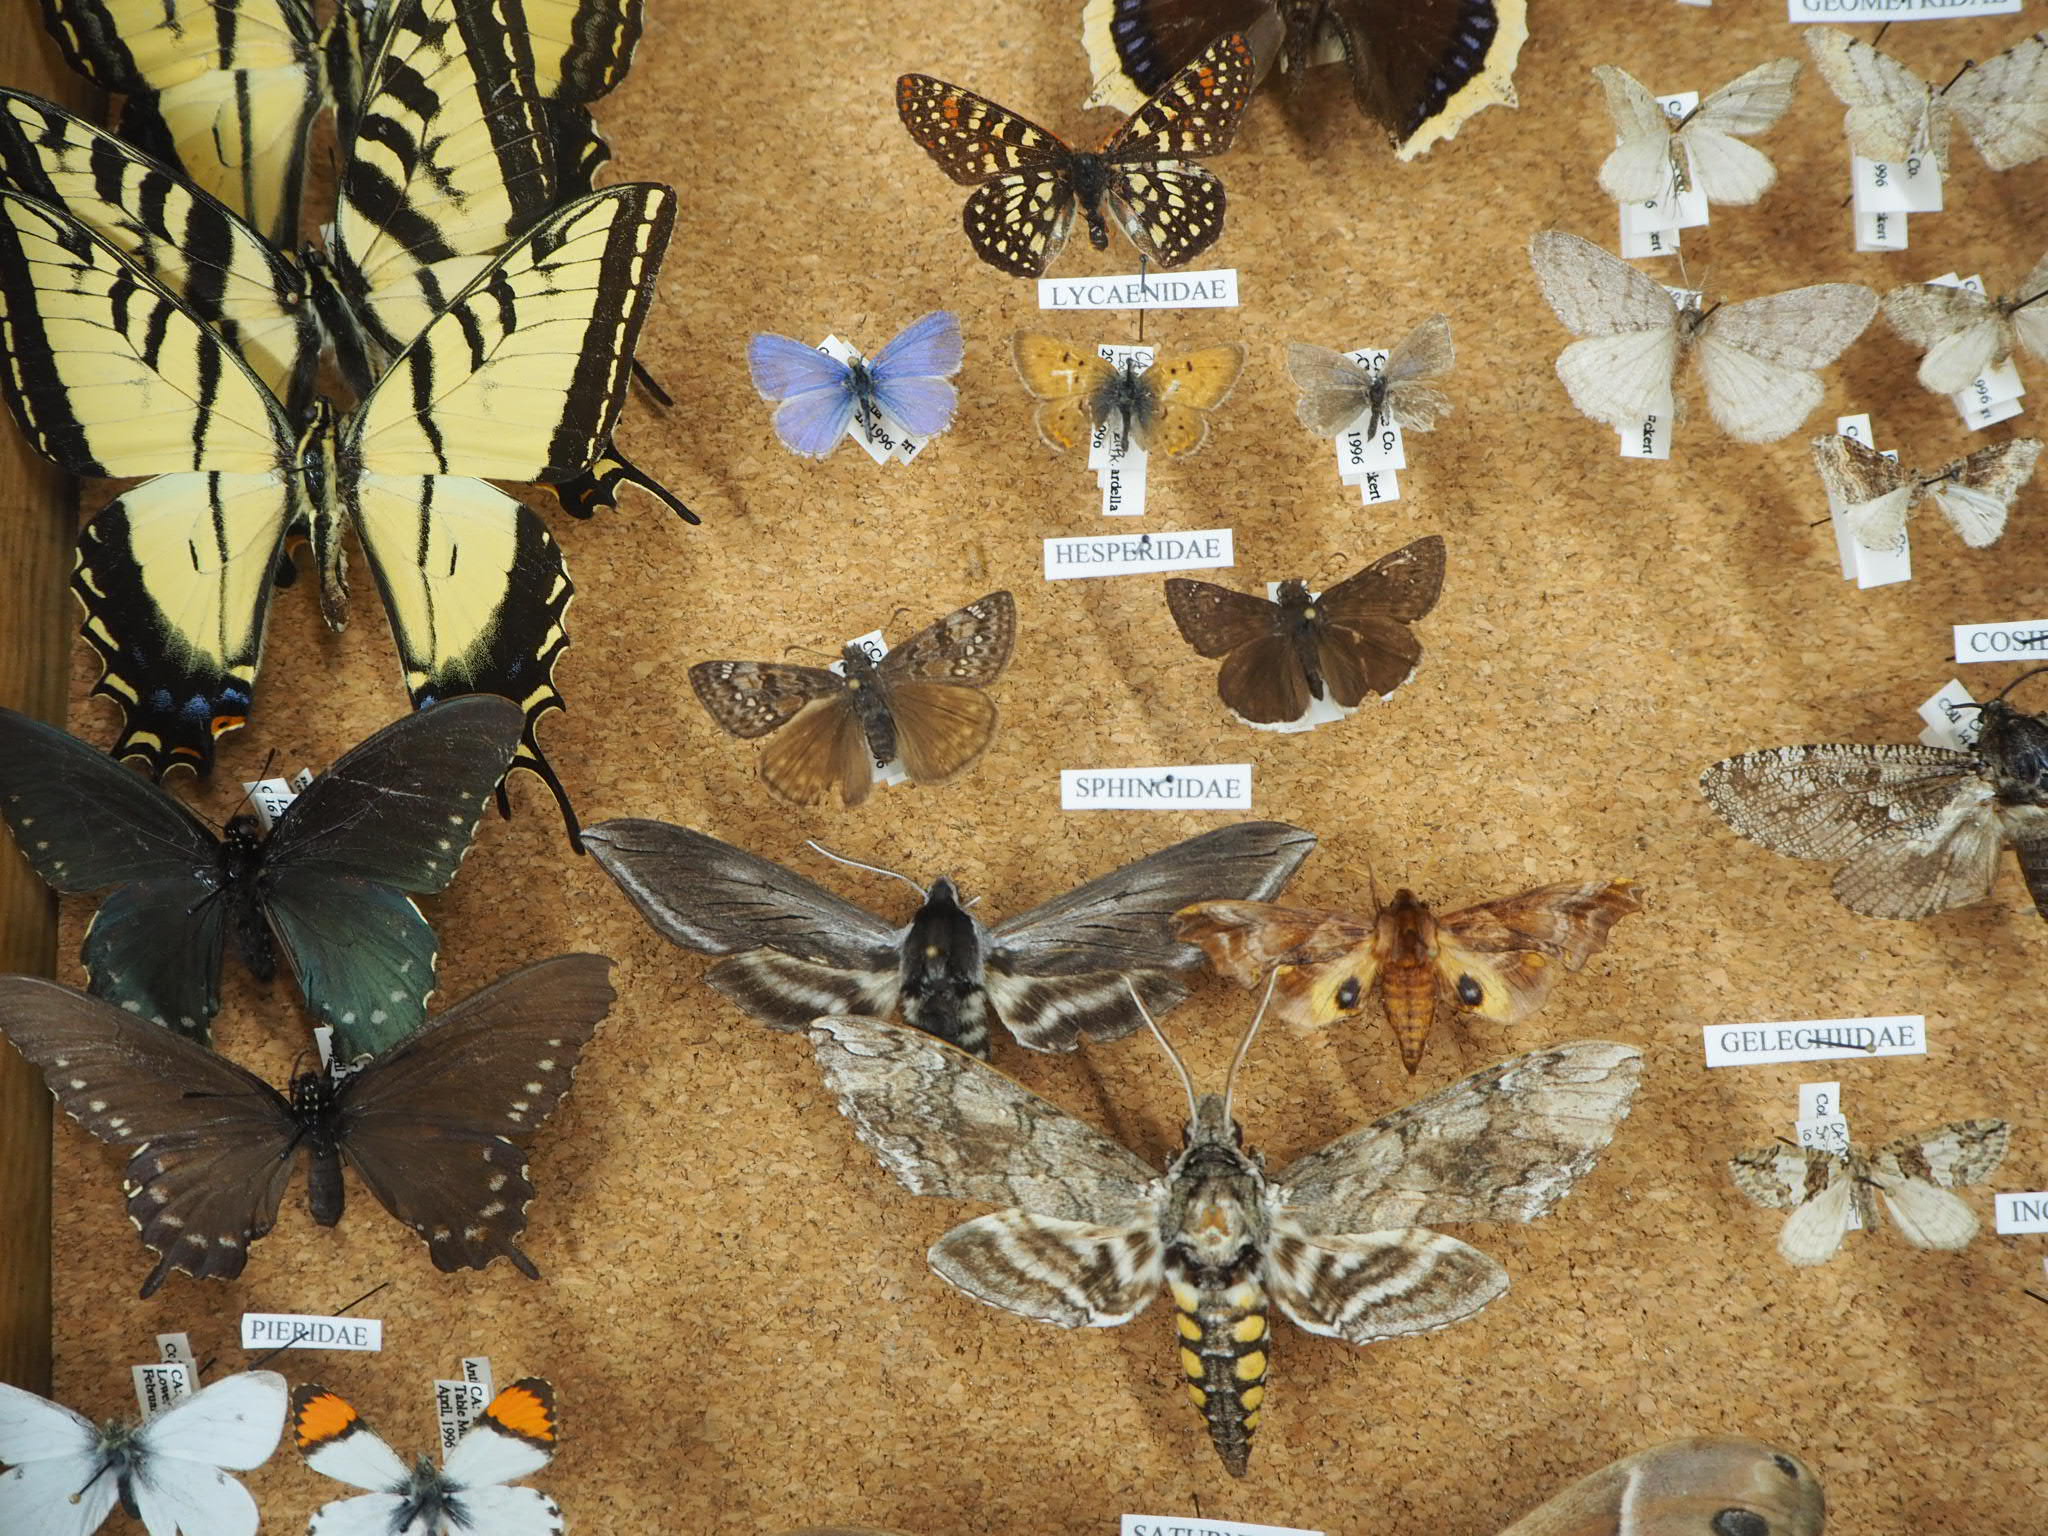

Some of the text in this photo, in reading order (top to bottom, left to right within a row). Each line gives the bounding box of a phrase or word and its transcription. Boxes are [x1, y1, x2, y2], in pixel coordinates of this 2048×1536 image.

[1803, 0, 2007, 11] GEOMET
[1874, 163, 1889, 187] 996
[1876, 212, 1889, 239] kert
[1052, 279, 1227, 306] LYCAENIDAE
[1974, 379, 1992, 404] 996
[870, 423, 896, 451] 1996
[1347, 431, 1364, 465] 1996
[1382, 431, 1395, 455] Co.
[1110, 469, 1122, 511] ardella
[1366, 472, 1380, 501] kert
[1056, 538, 1221, 564] HESPERIDAE
[1075, 777, 1241, 798] SPHINGIDAE
[1721, 1025, 1916, 1053] GELECHIIDAE
[251, 1320, 368, 1346] PIERIDAE
[142, 1368, 157, 1412] Februa
[454, 1384, 468, 1417] Table
[470, 1385, 482, 1409] CA:
[436, 1384, 457, 1448] April, 1996
